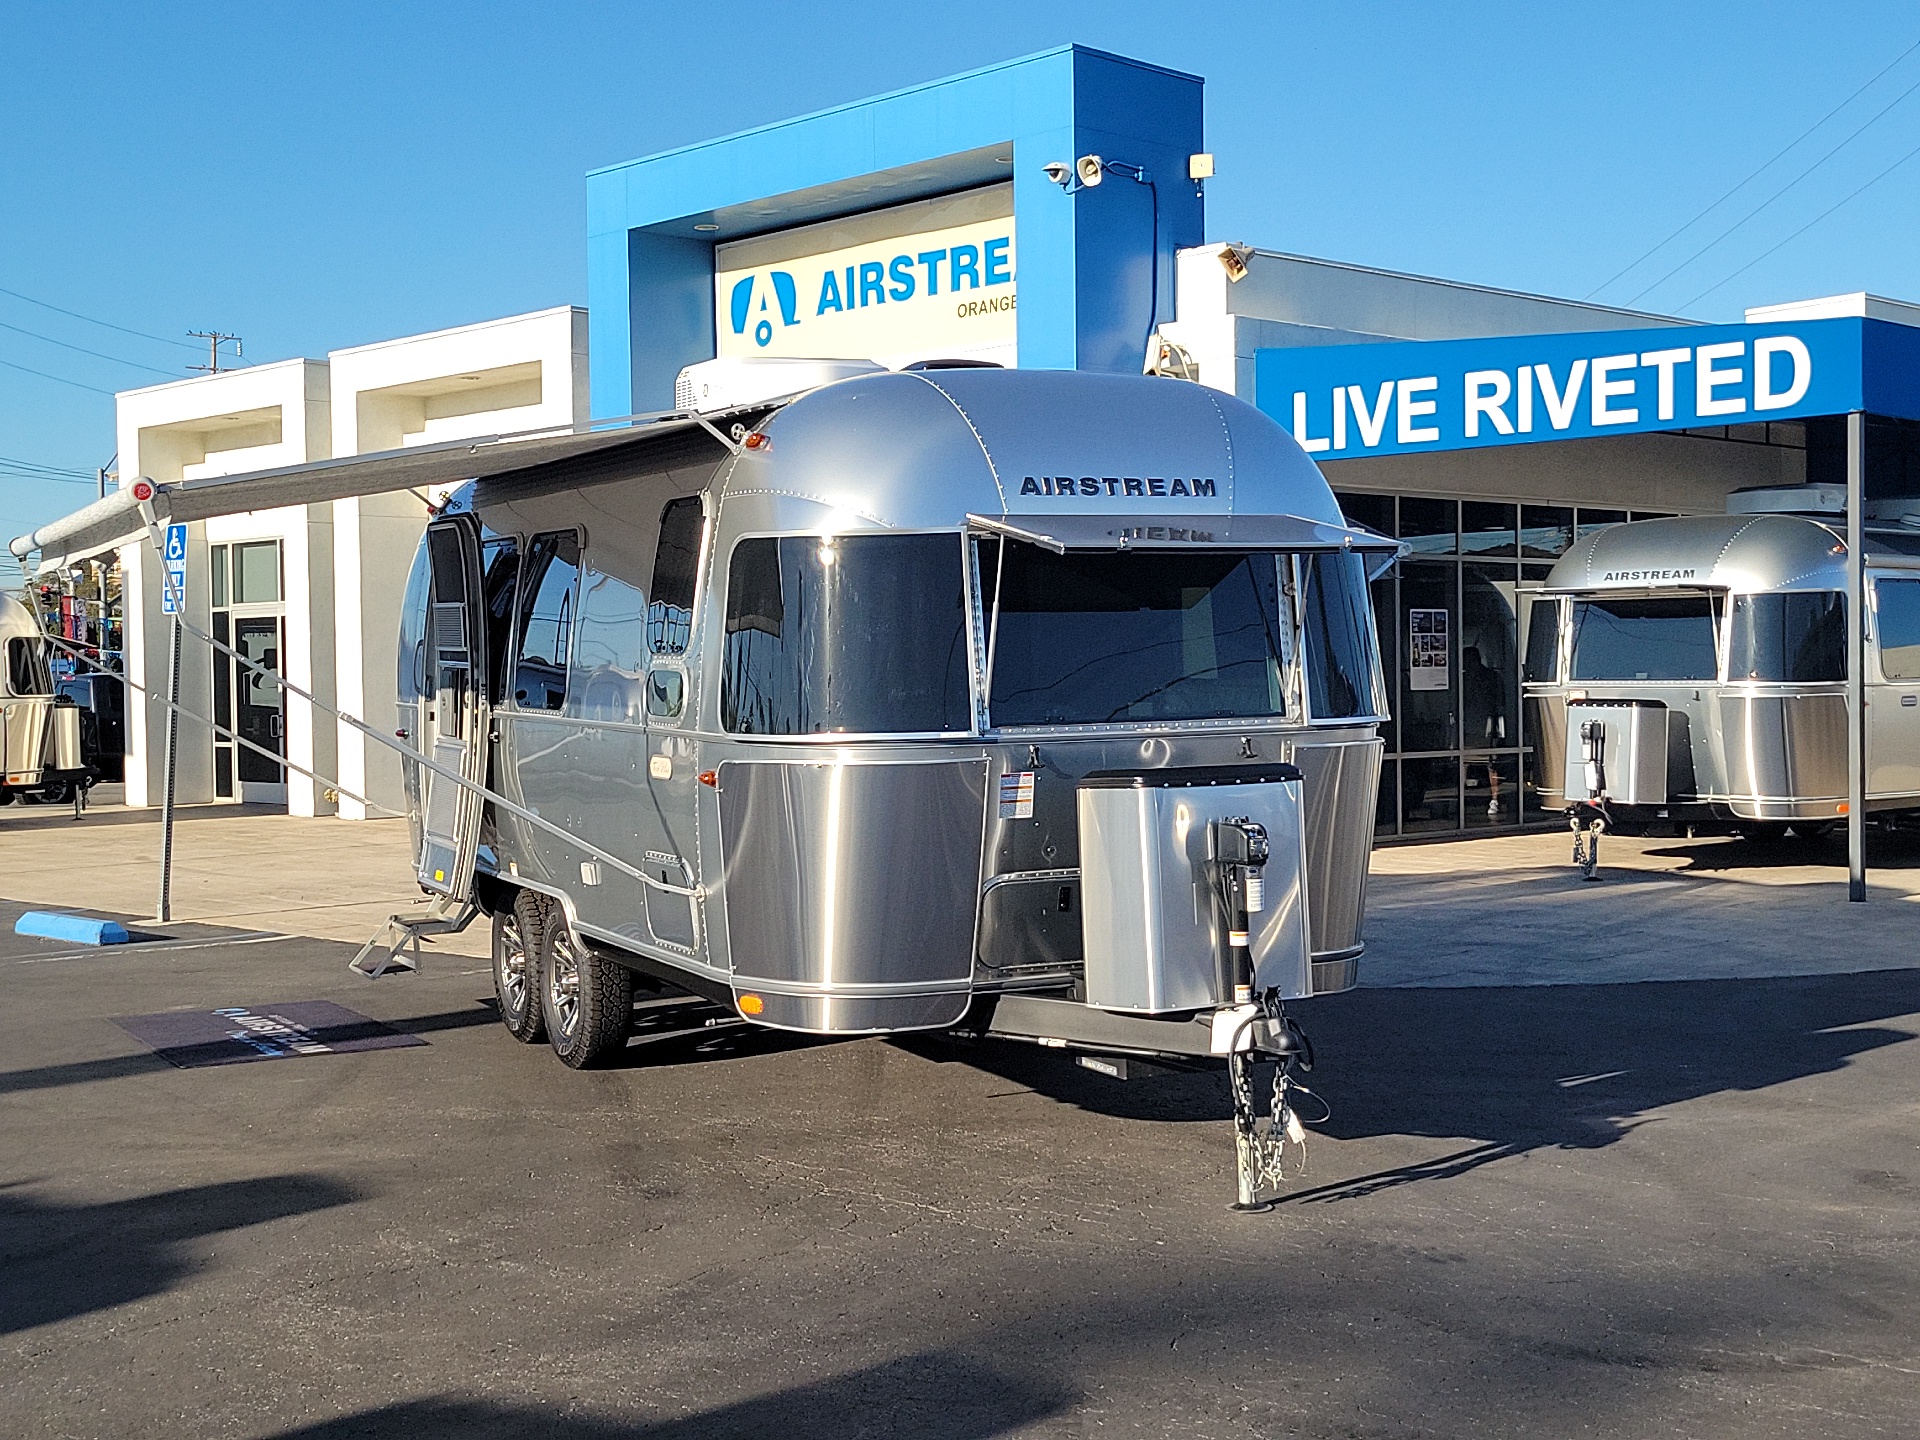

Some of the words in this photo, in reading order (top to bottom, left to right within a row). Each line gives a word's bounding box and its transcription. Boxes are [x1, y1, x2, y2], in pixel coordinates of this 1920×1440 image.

[816, 236, 1016, 316] AIRSTRE
[957, 294, 1016, 319] ORANGE
[1292, 376, 1440, 453] LIVE
[1463, 335, 1813, 438] RIVETED
[1019, 476, 1217, 498] AIRSTREAM
[1603, 569, 1696, 581] AIRSTREAM
